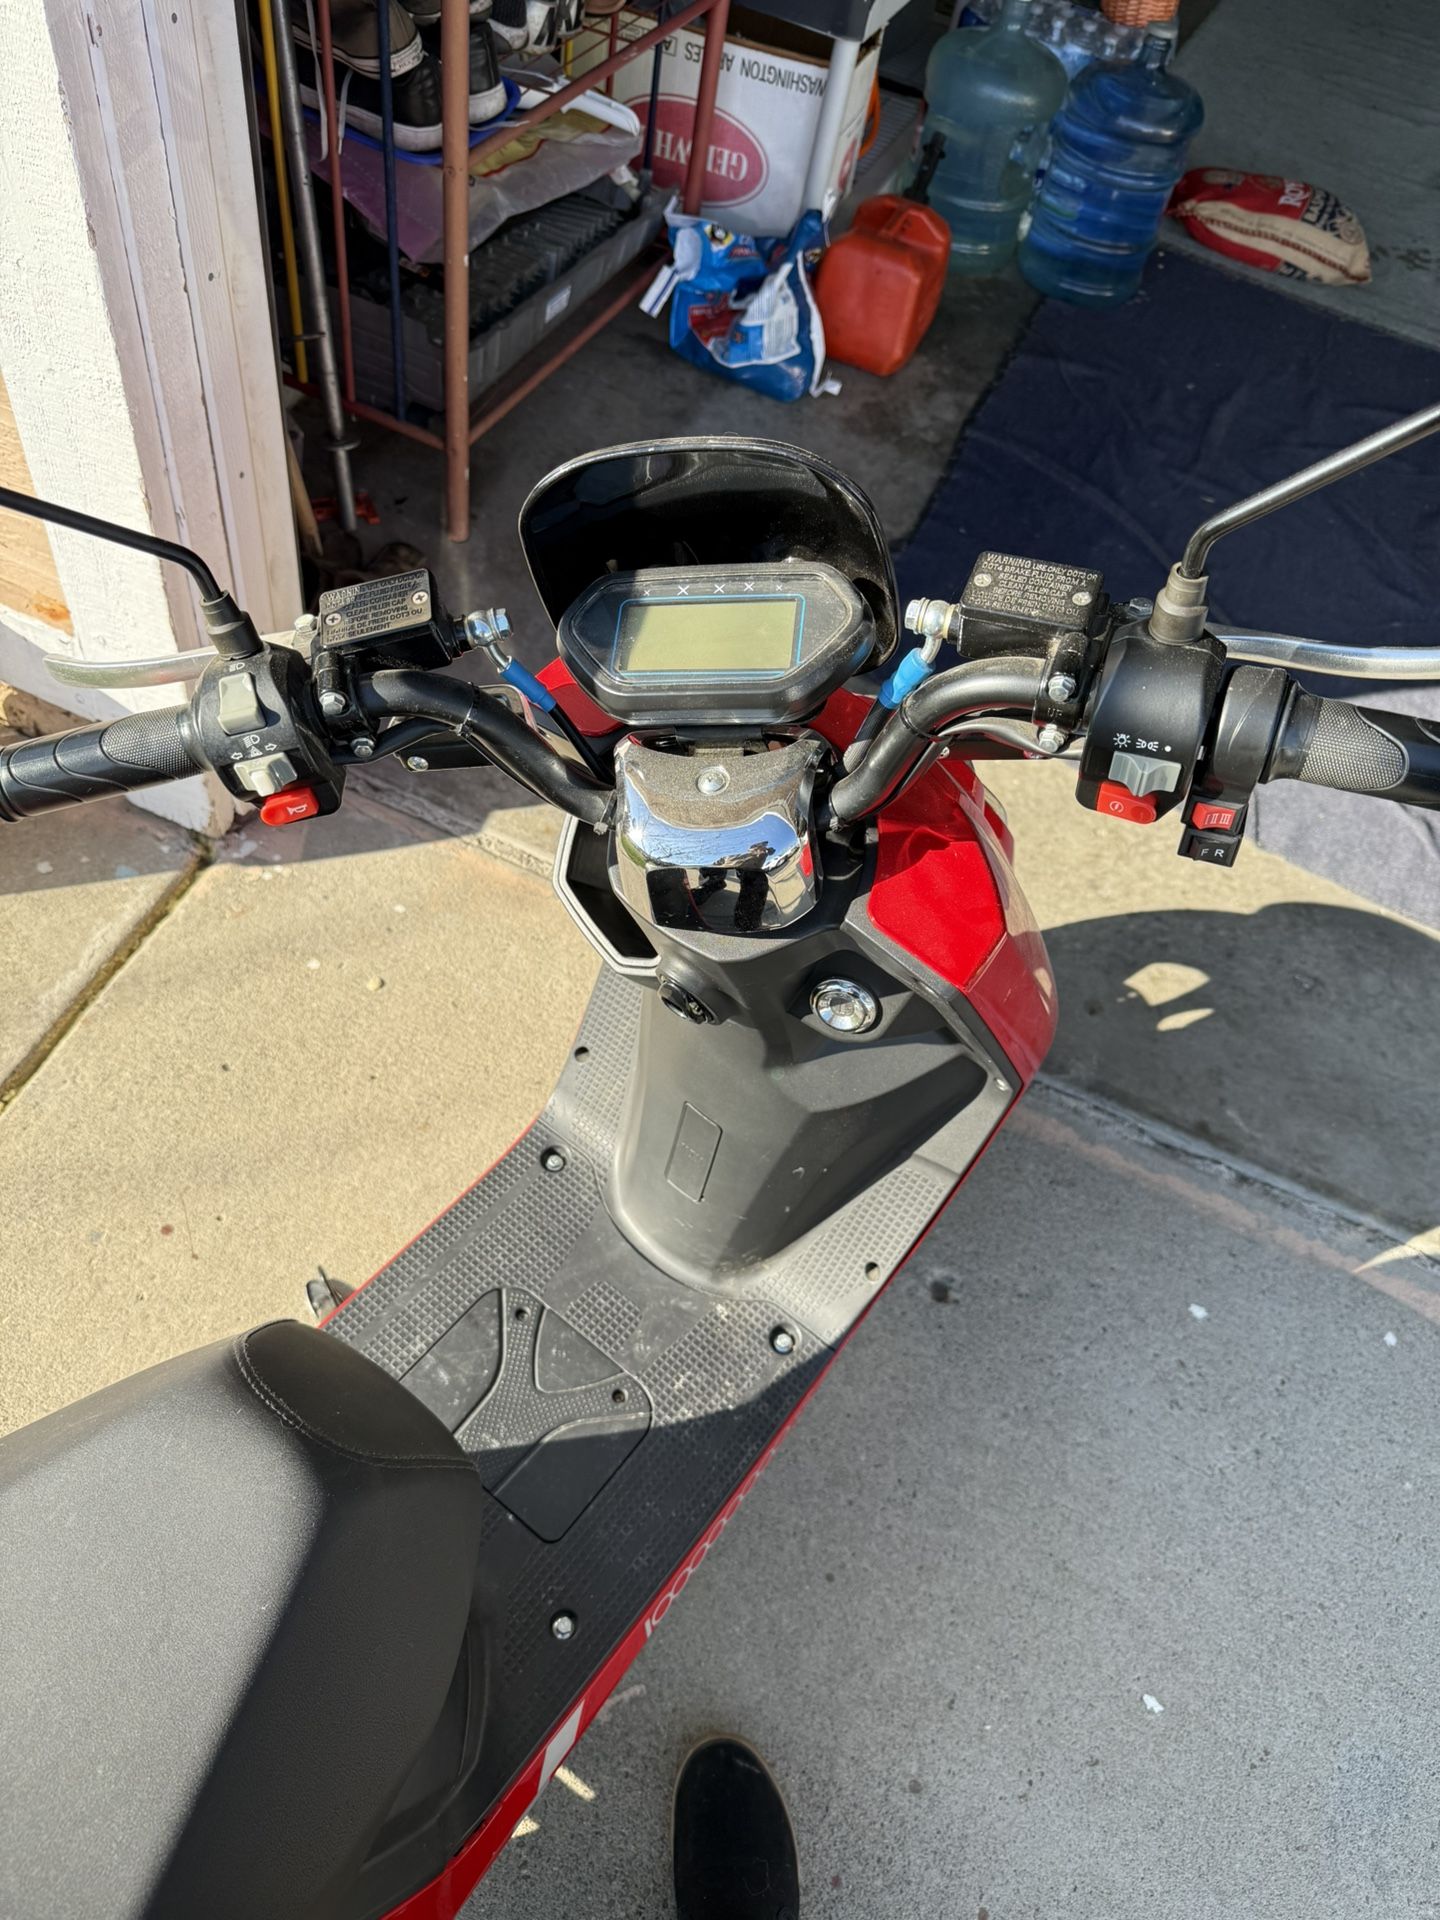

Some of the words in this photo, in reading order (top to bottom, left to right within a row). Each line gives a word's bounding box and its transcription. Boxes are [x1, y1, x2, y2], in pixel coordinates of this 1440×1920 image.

[685, 41, 735, 72] APES
[740, 59, 827, 96] WASHINGTON
[981, 561, 1003, 571] DOT4
[1003, 566, 1031, 576] BRAKE
[1031, 571, 1055, 580] FLUID
[1056, 575, 1079, 586] FROM
[987, 553, 1032, 569] WARNING
[1032, 563, 1047, 571] USE
[1047, 566, 1067, 575] ONLY
[1067, 569, 1087, 579] DOT3
[998, 572, 1028, 583] SEALED
[1028, 578, 1073, 592] CONTAINER
[998, 580, 1025, 590] CLEAN
[392, 598, 406, 606] CAP
[993, 586, 1023, 597] BEFORE
[1023, 592, 1066, 606] REMOVING
[371, 604, 409, 618] REMOVING
[390, 611, 411, 621] DOT3
[411, 608, 423, 616] OU
[1201, 848, 1210, 857] F
[1214, 848, 1225, 858] R
